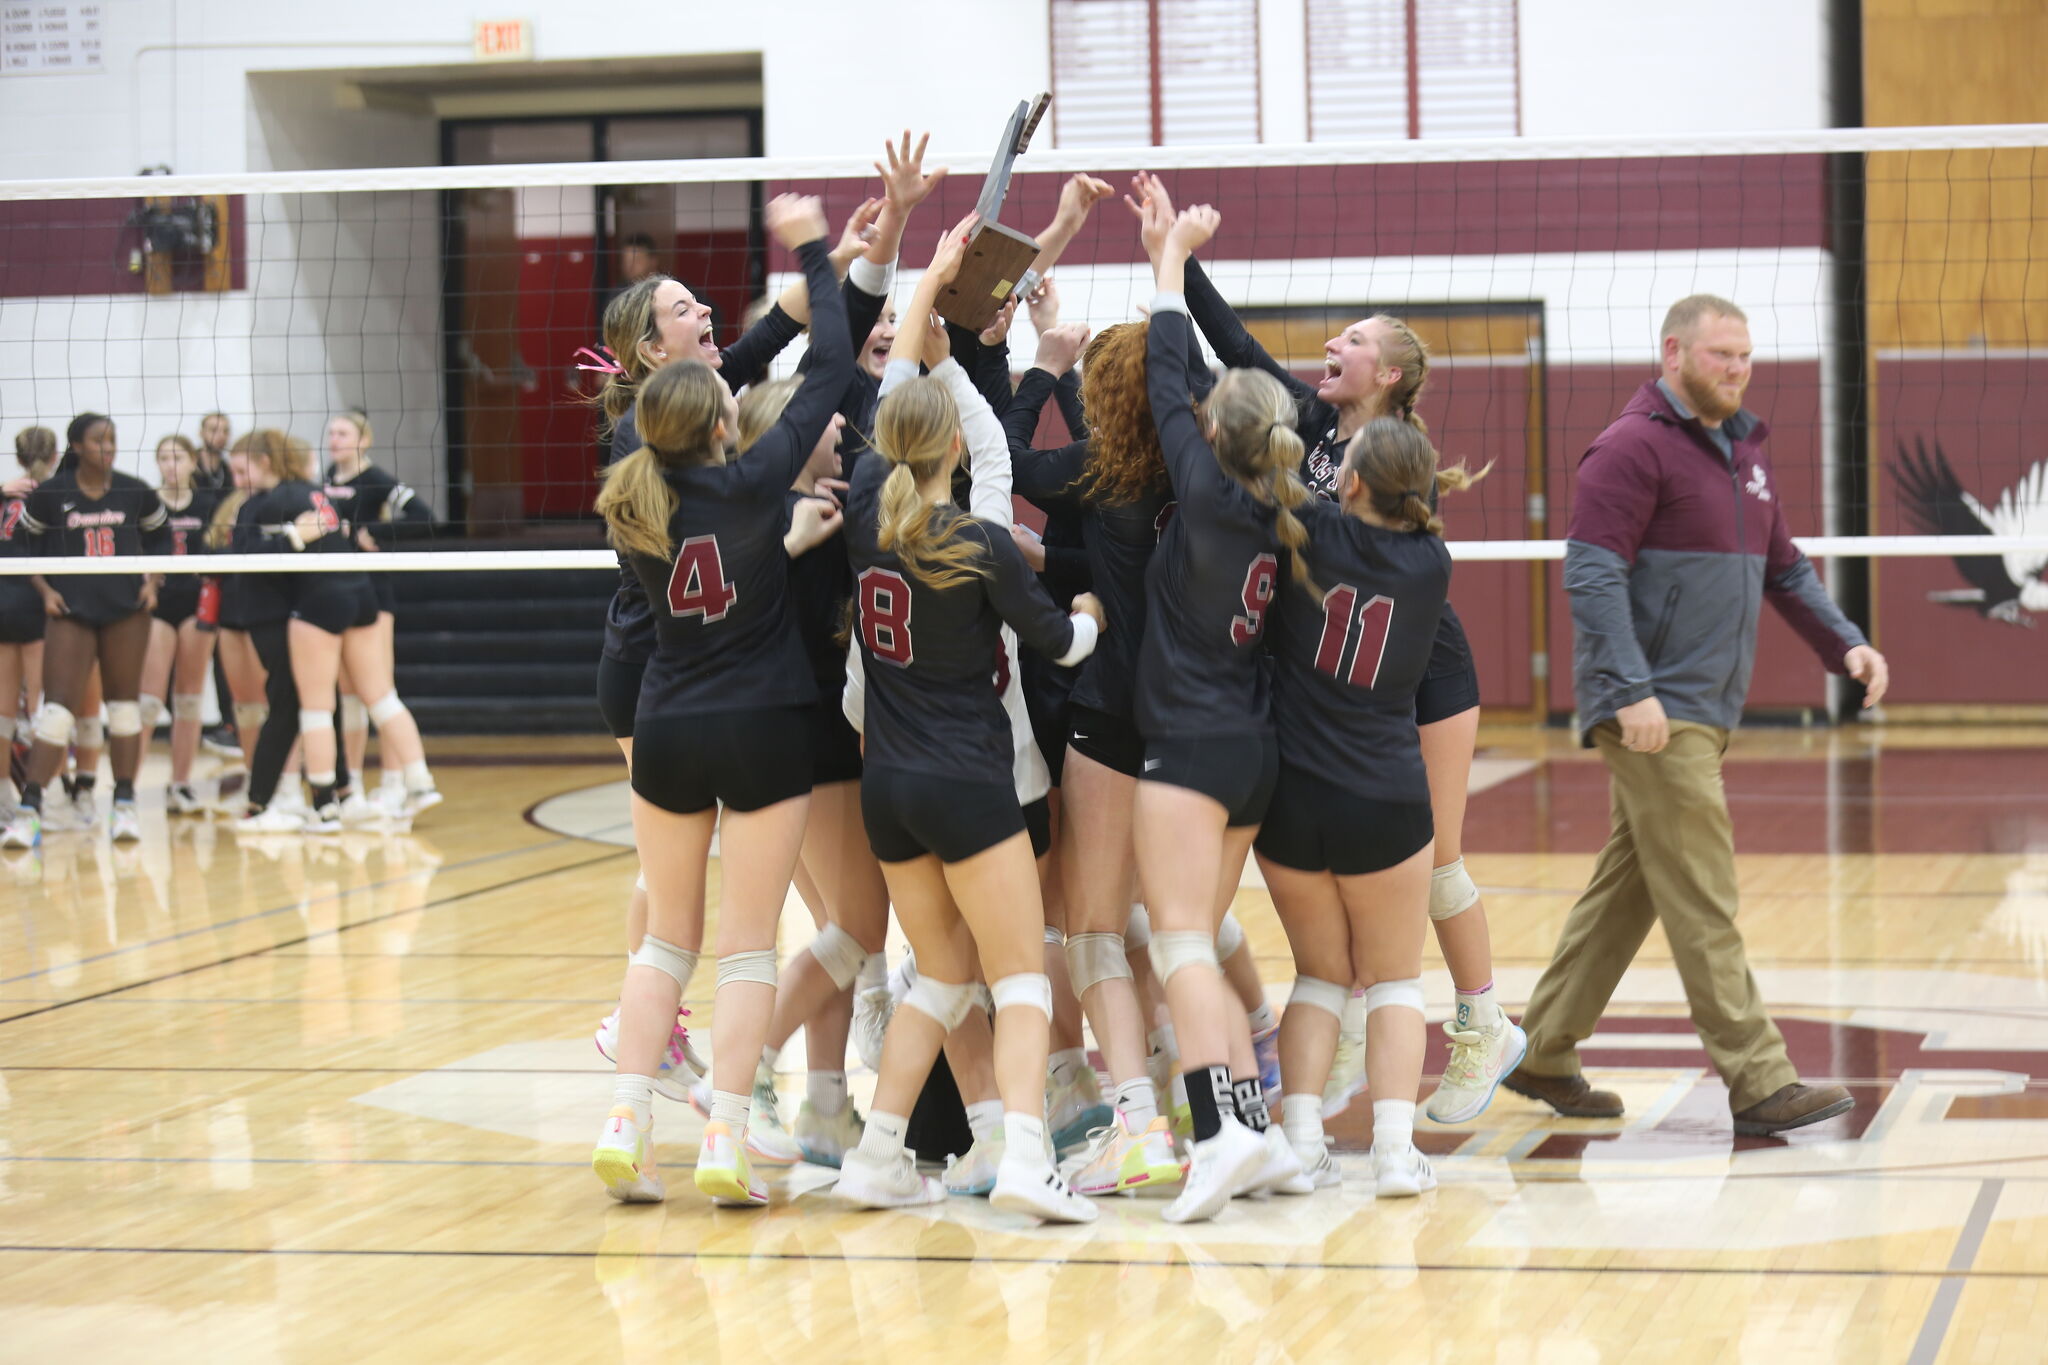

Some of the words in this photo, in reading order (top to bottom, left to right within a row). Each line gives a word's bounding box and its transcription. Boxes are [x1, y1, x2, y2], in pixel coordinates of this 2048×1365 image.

[482, 21, 521, 53] EXIT
[667, 534, 737, 625] 4
[858, 566, 913, 668] 8
[1230, 552, 1277, 647] 9
[1314, 583, 1394, 690] 11
